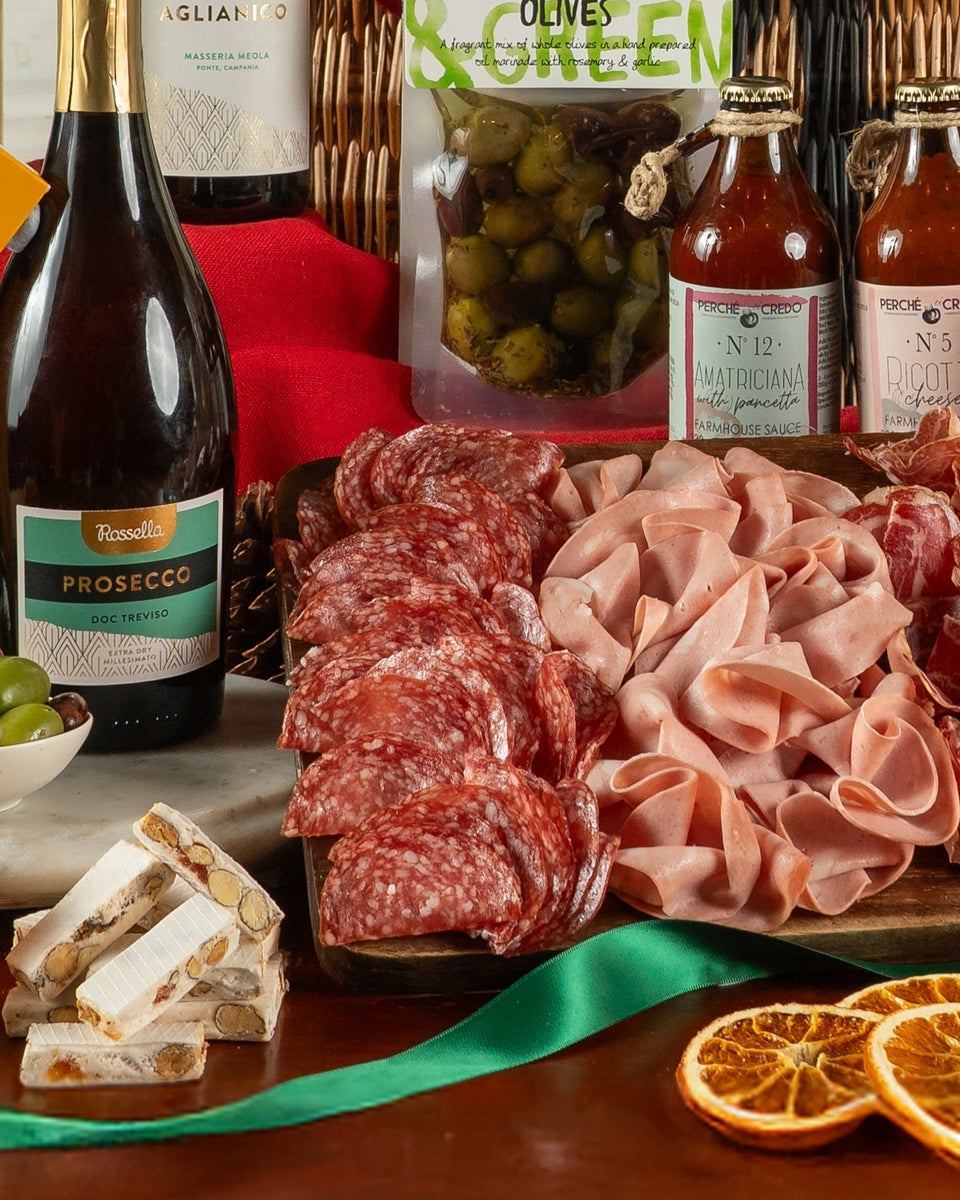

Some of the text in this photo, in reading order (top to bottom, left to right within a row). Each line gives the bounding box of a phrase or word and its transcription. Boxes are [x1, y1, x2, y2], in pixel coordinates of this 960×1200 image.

[160, 3, 288, 22] AGLIANICO
[439, 38, 697, 53] A fragrant mix of whole olives in a hand prepared
[184, 52, 270, 61] MASSERIA MEOLA
[475, 54, 661, 71] oil marinade with rosemary & garlic
[697, 299, 740, 315] PERCHÉ
[761, 302, 802, 315] CREDO
[880, 296, 922, 310] PERCHÉ
[755, 336, 772, 356] 12
[941, 332, 952, 352] 5
[694, 360, 805, 391] AMATRICIANA
[696, 387, 801, 415] with pancetta
[694, 419, 801, 436] FARMHOUSE SAUCE
[884, 415, 919, 427] FARMH
[96, 520, 164, 542] Rossella
[63, 565, 192, 593] PROSECCO
[91, 609, 169, 624] DOC TREVISO
[103, 654, 157, 665] MILLESIMATO
[108, 646, 152, 657] EXTRA DRY
